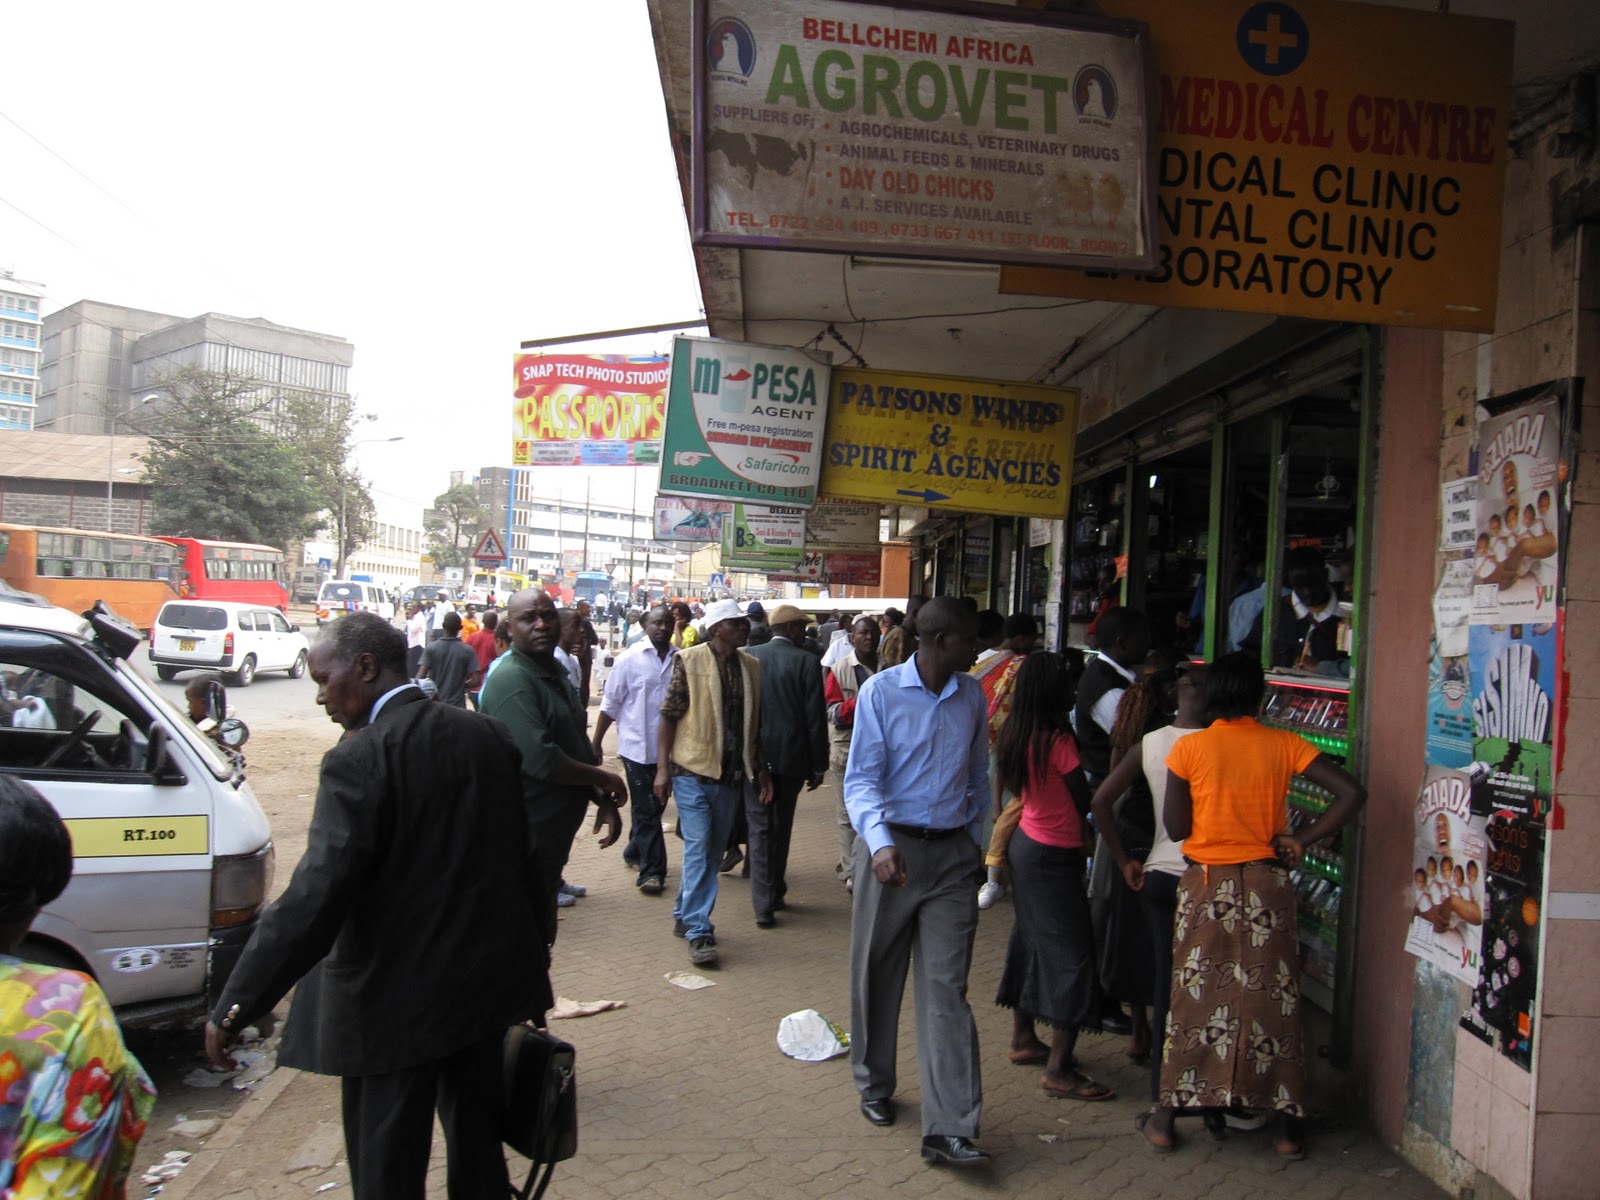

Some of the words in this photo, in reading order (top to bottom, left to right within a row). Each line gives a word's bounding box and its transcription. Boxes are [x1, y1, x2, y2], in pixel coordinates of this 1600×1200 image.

[803, 17, 937, 55] BELLCHEM
[945, 34, 1034, 66] AFRICA
[765, 43, 1069, 135] AGROVET
[712, 103, 788, 124] SUPPLIERS
[1157, 74, 1334, 150] MEDICAL
[1347, 93, 1496, 165] CENTRE
[839, 119, 973, 150] AGROCHEMICALS,
[977, 134, 1069, 157] VETERINARY
[1072, 143, 1121, 162] DRUGS
[839, 143, 898, 163] ANIMAL
[903, 149, 950, 168] FEEDS
[955, 155, 965, 168] &
[970, 155, 1045, 177] MINERALS
[839, 165, 876, 190] DAY
[882, 170, 919, 194] OLD
[925, 173, 995, 203] CHICKS
[1158, 146, 1296, 200] DICAL
[1313, 164, 1461, 216] CLINIC
[874, 198, 948, 219] SERVICES
[953, 205, 1033, 226] AVAILABLE
[1157, 195, 1268, 245] NTAL
[1288, 208, 1437, 261] CLINIC
[1084, 244, 1394, 305] BORATORY
[522, 363, 554, 381] SNAP
[556, 363, 584, 379] TECH
[586, 365, 625, 384] PHOTO
[751, 362, 817, 406] PESA
[522, 394, 666, 439] PASSPORTS
[751, 405, 815, 421] AGENT
[839, 381, 962, 417] PATSONS
[971, 395, 1059, 426] WINES
[707, 418, 727, 429] Free
[728, 421, 762, 434] m-pesa
[763, 424, 814, 439] registration
[929, 423, 951, 448] &
[744, 457, 810, 475] Safaricom
[828, 442, 917, 474] SPIRIT
[925, 452, 1062, 487] AGENCIES
[669, 474, 753, 493] BROADNETT
[783, 486, 808, 499] LTD
[1535, 584, 1554, 611] yu
[1532, 798, 1547, 818] yu
[123, 829, 176, 842] RT.100
[1460, 945, 1477, 969] yu
